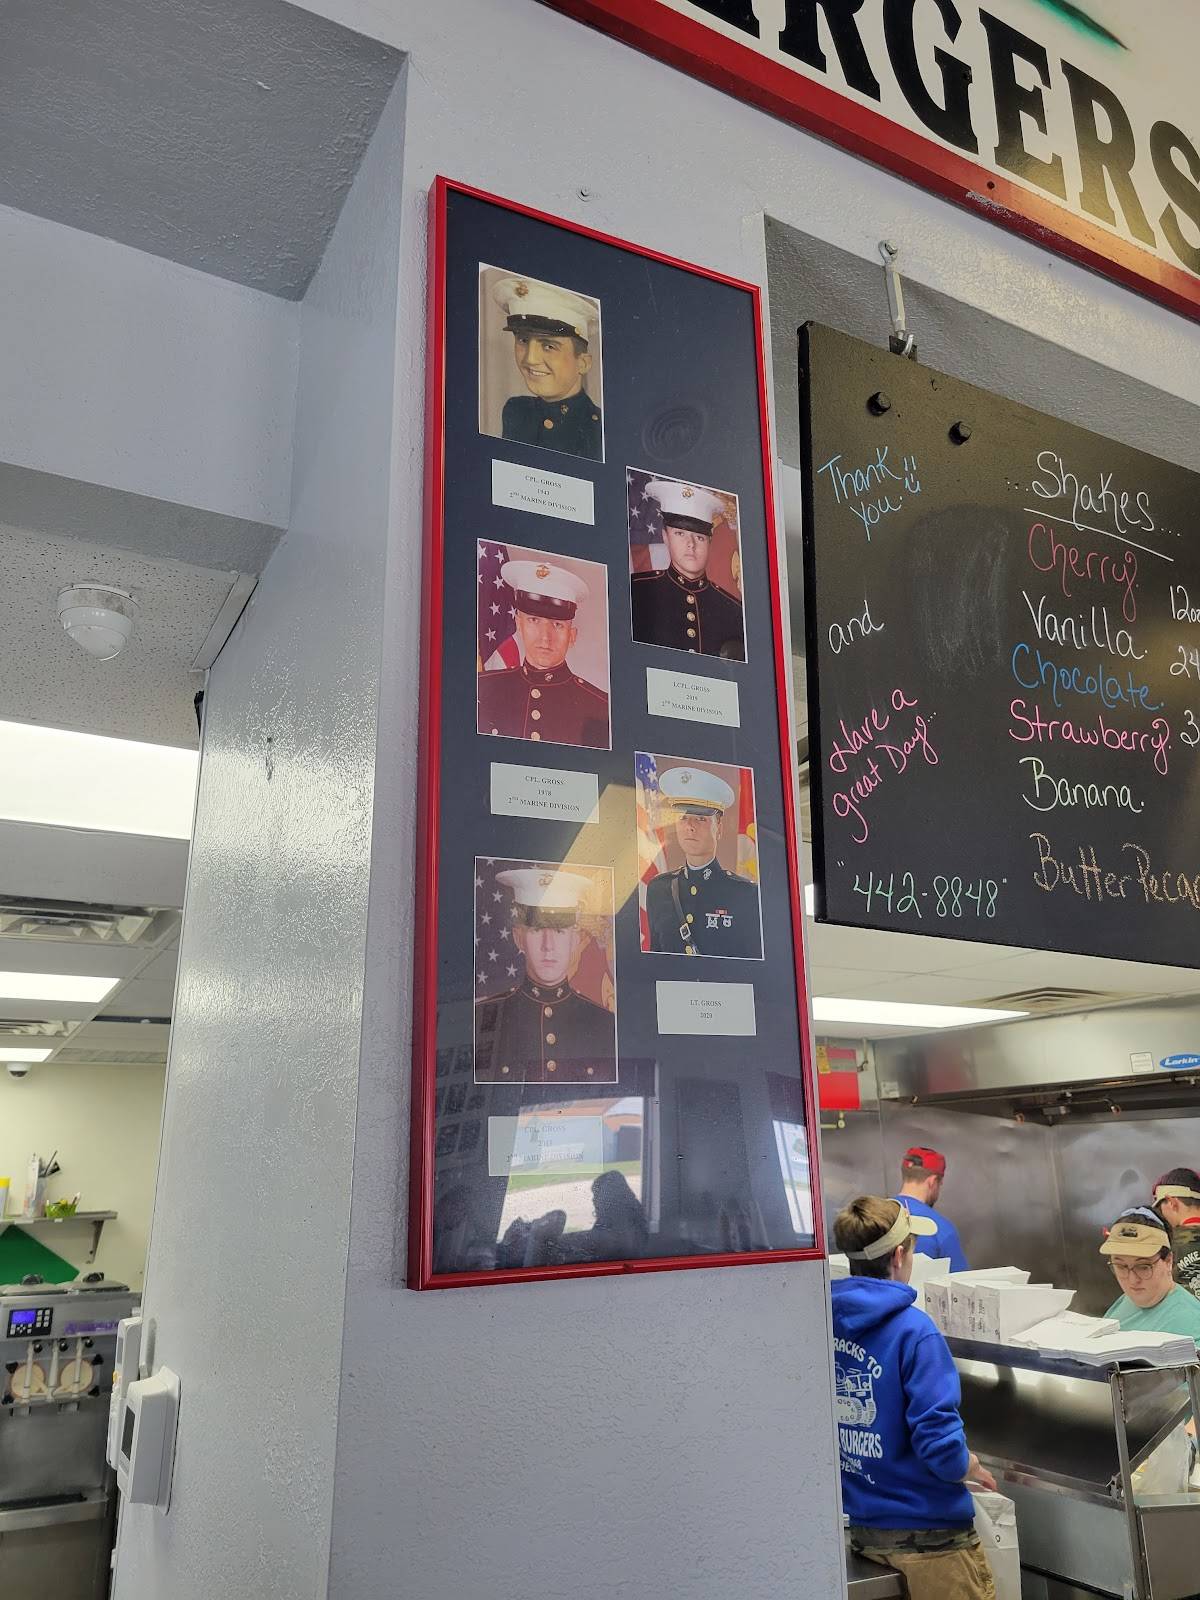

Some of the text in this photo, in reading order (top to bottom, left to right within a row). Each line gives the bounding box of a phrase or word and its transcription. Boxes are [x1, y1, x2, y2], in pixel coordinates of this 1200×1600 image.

[685, 0, 1200, 278] RGERS
[541, 479, 561, 488] GROSS
[817, 446, 902, 503] Thank
[521, 495, 547, 505] MARINE
[548, 501, 576, 512] DIVISION
[828, 600, 886, 654] and
[691, 684, 710, 693] GROSS
[671, 702, 696, 712] MARINE
[697, 707, 723, 716] DIVISION
[829, 689, 918, 773] Have a
[519, 799, 549, 808] MARINE
[549, 802, 580, 812] DIVISION
[1029, 832, 1132, 901] Butter
[700, 1000, 722, 1008] GROSS
[866, 1355, 883, 1380] TO
[838, 1427, 883, 1459] BURGERS
